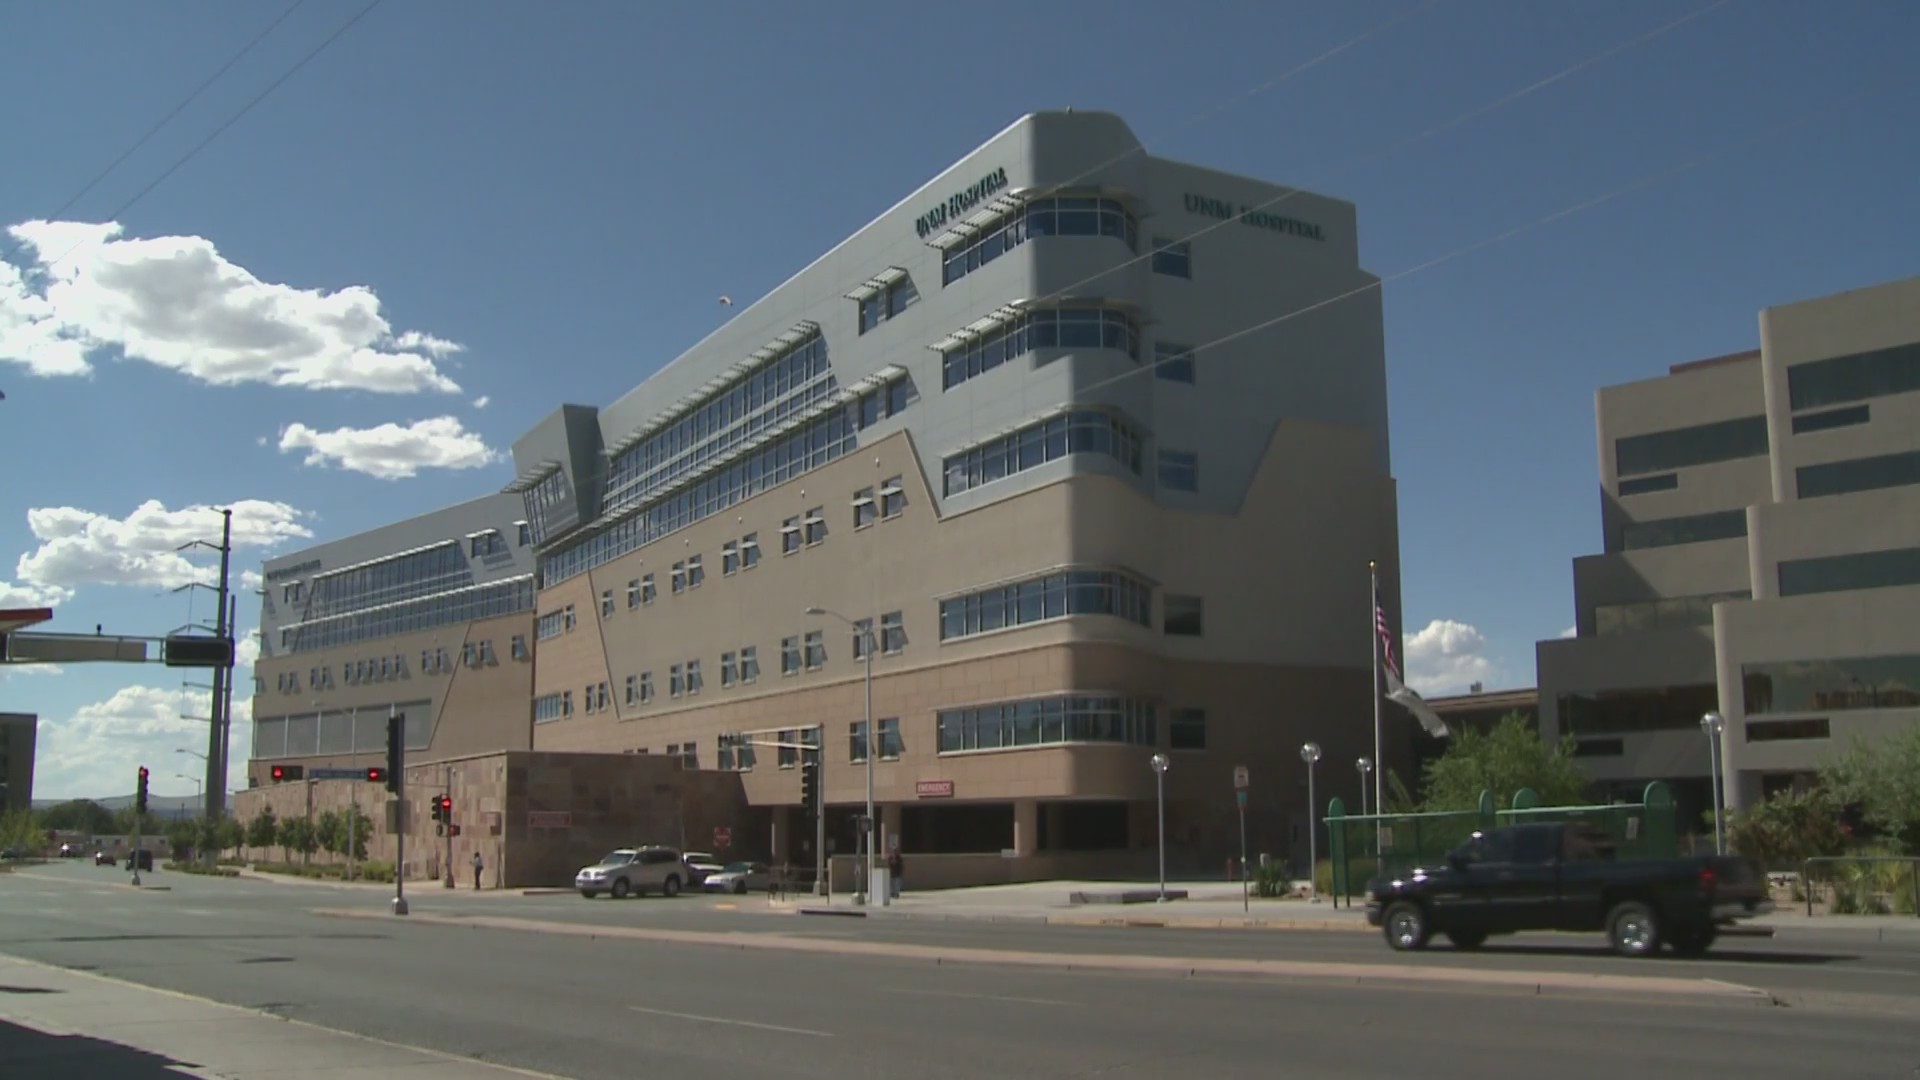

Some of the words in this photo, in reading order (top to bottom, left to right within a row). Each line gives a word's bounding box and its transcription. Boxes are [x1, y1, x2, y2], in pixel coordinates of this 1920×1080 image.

[916, 203, 947, 238] UNM
[949, 166, 1008, 219] HOSPITAL
[1184, 192, 1233, 221] UNM
[1239, 204, 1326, 242] HOSPITAL
